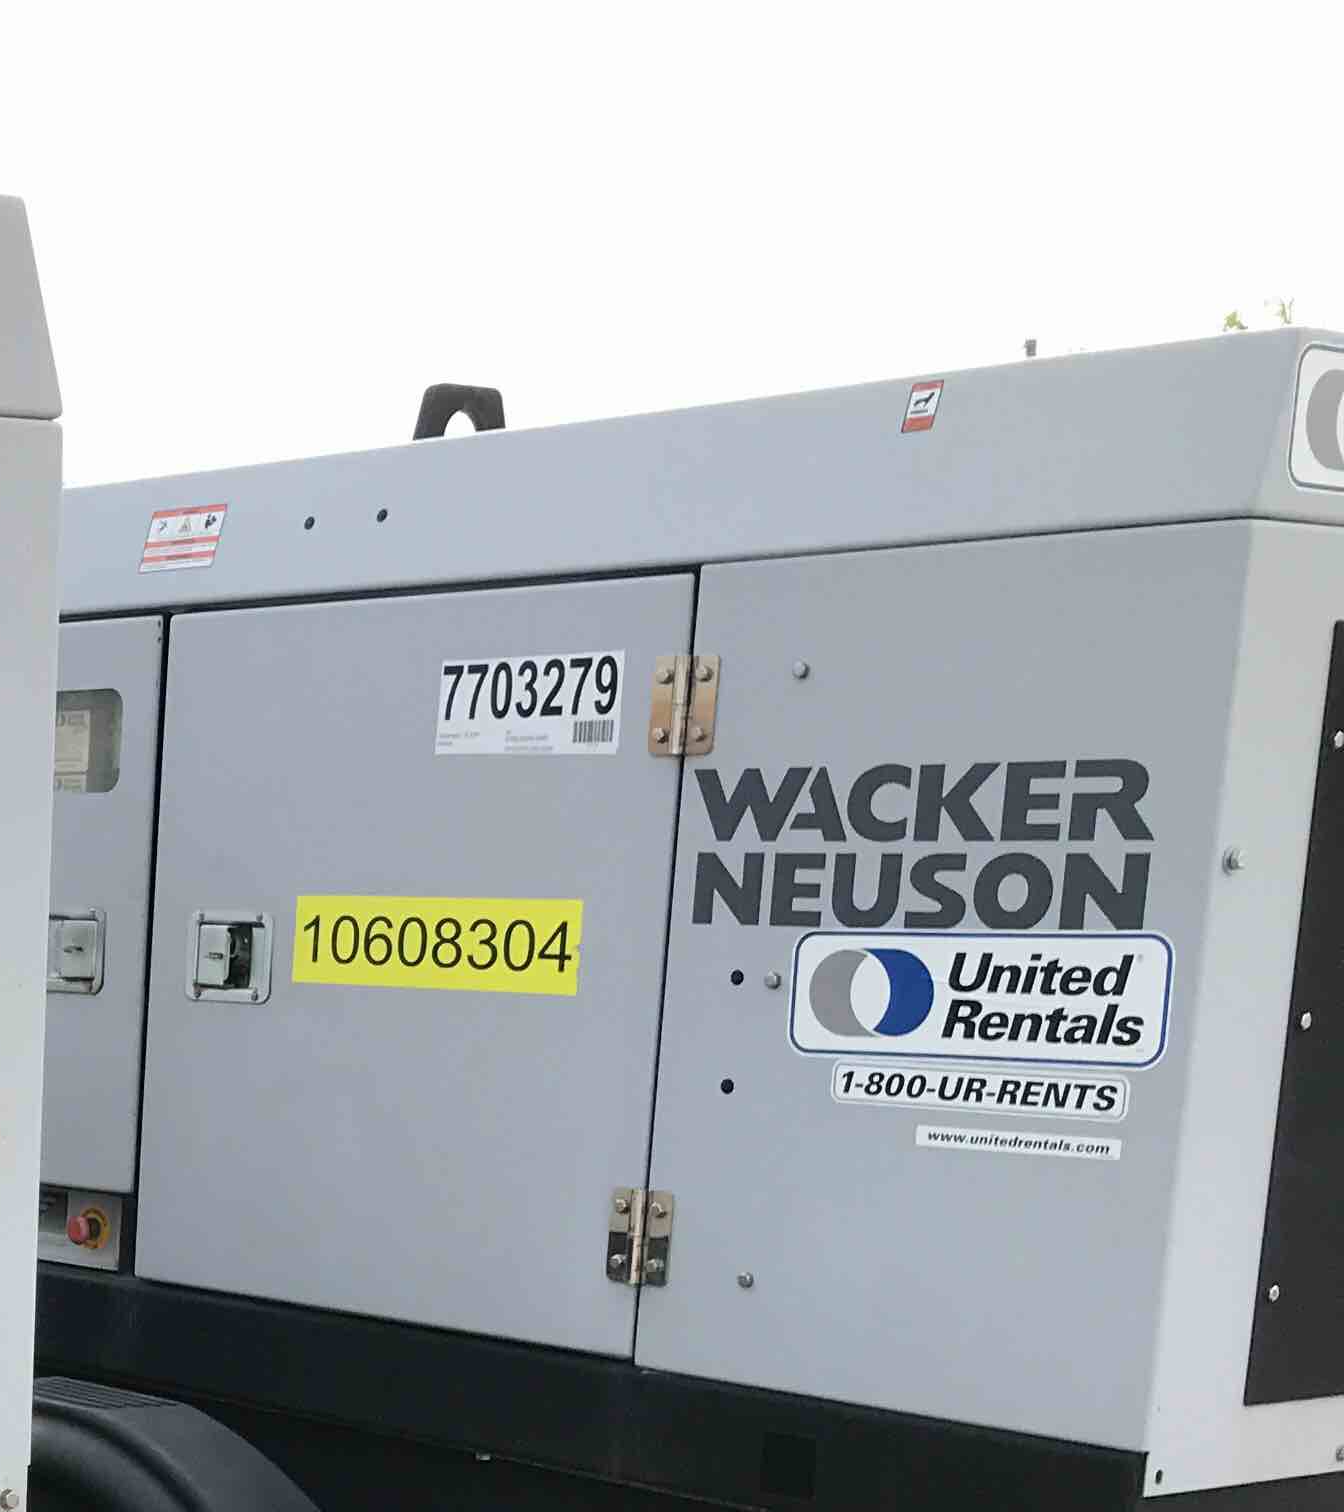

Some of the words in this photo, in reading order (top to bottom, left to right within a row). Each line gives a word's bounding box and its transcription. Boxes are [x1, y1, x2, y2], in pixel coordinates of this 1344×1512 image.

[443, 656, 618, 720] 7703279
[693, 758, 1155, 843] WACKER
[691, 851, 1152, 930] NEUSON
[302, 915, 573, 974] 10608304
[947, 952, 1135, 997] United
[941, 999, 1144, 1047] Rentals
[840, 1071, 1119, 1112] 1-800-UR-RENTS
[927, 1131, 1111, 1155] www.unitedrentals.com
